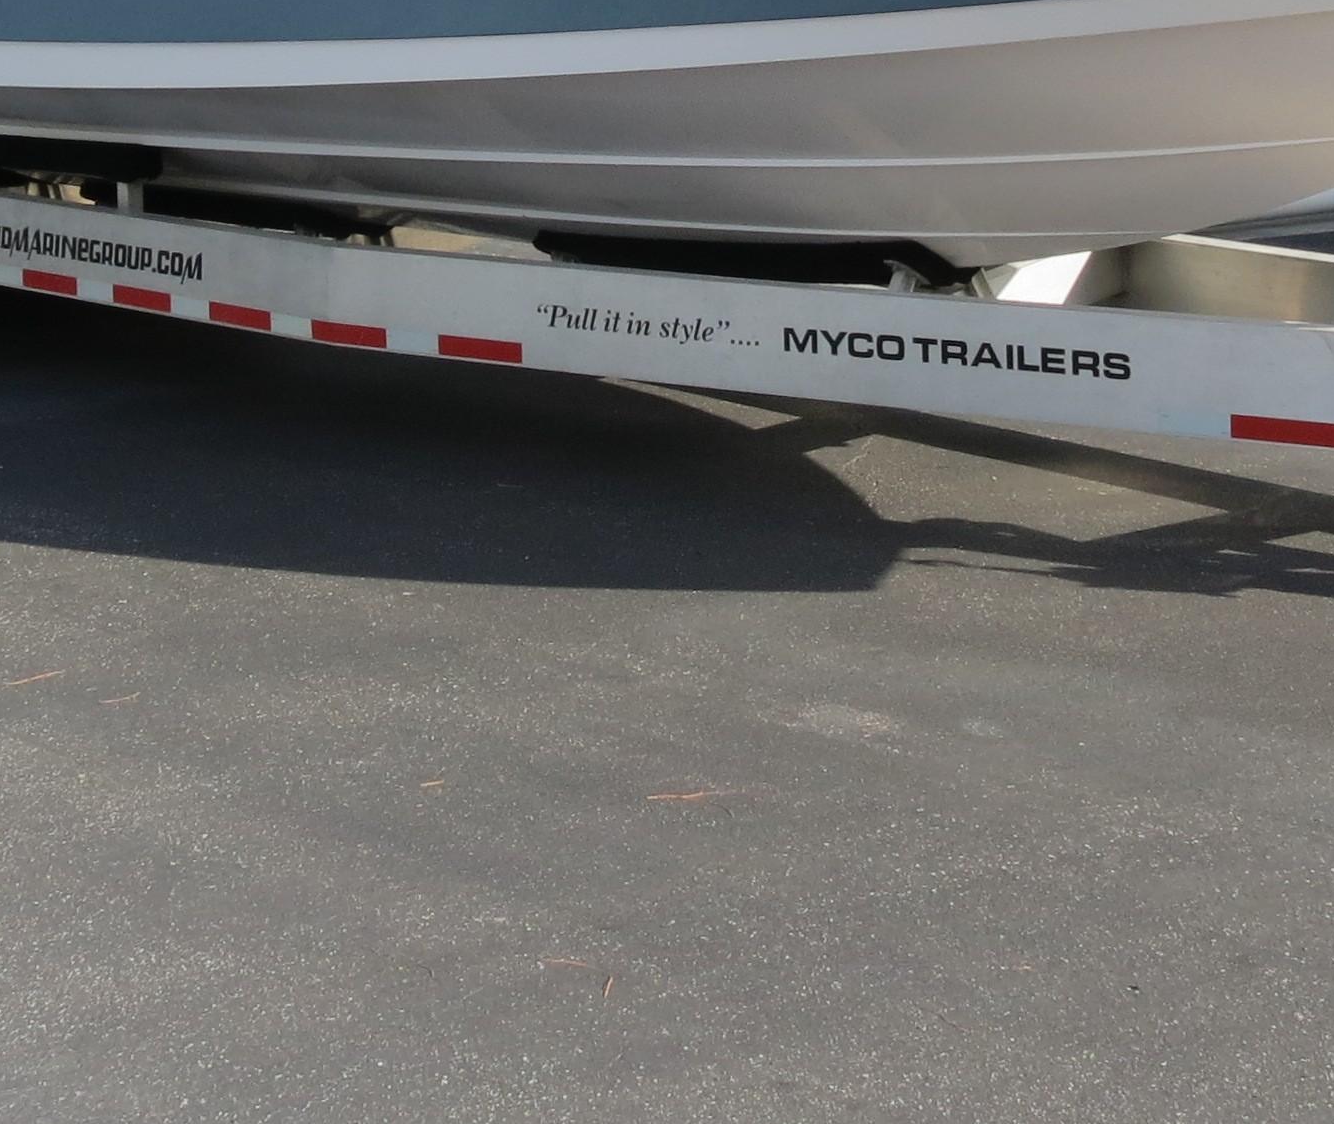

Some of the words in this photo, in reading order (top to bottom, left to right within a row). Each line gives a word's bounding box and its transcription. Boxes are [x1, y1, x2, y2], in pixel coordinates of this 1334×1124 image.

[604, 309, 621, 333] it
[626, 311, 652, 336] in
[783, 327, 905, 361] MYCO
[912, 336, 1132, 381] TRAILERS
